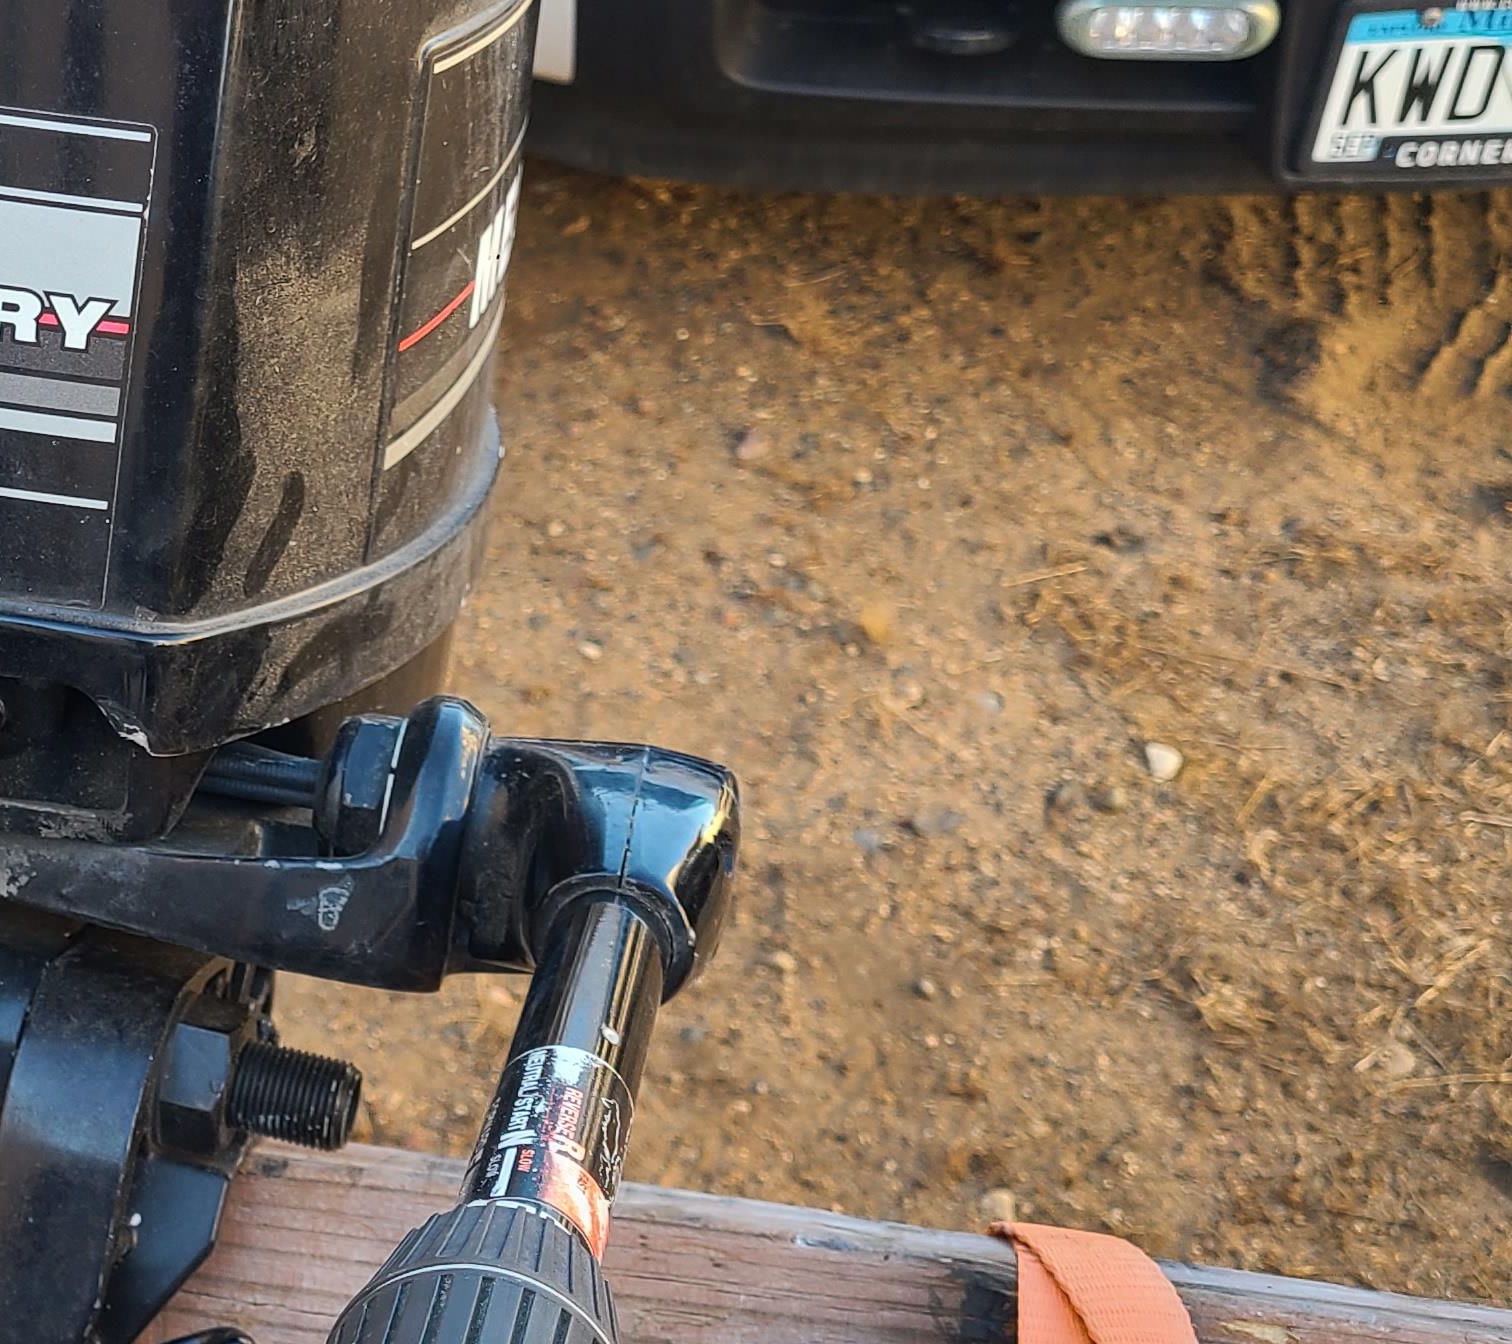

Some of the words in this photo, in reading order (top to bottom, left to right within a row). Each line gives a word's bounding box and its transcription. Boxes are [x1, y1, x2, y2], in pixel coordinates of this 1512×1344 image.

[1342, 45, 1506, 126] KWD
[554, 1086, 584, 1143] REVERSE
[497, 1129, 538, 1151] N
[549, 1129, 586, 1162] R
[516, 1148, 536, 1173] SLOW
